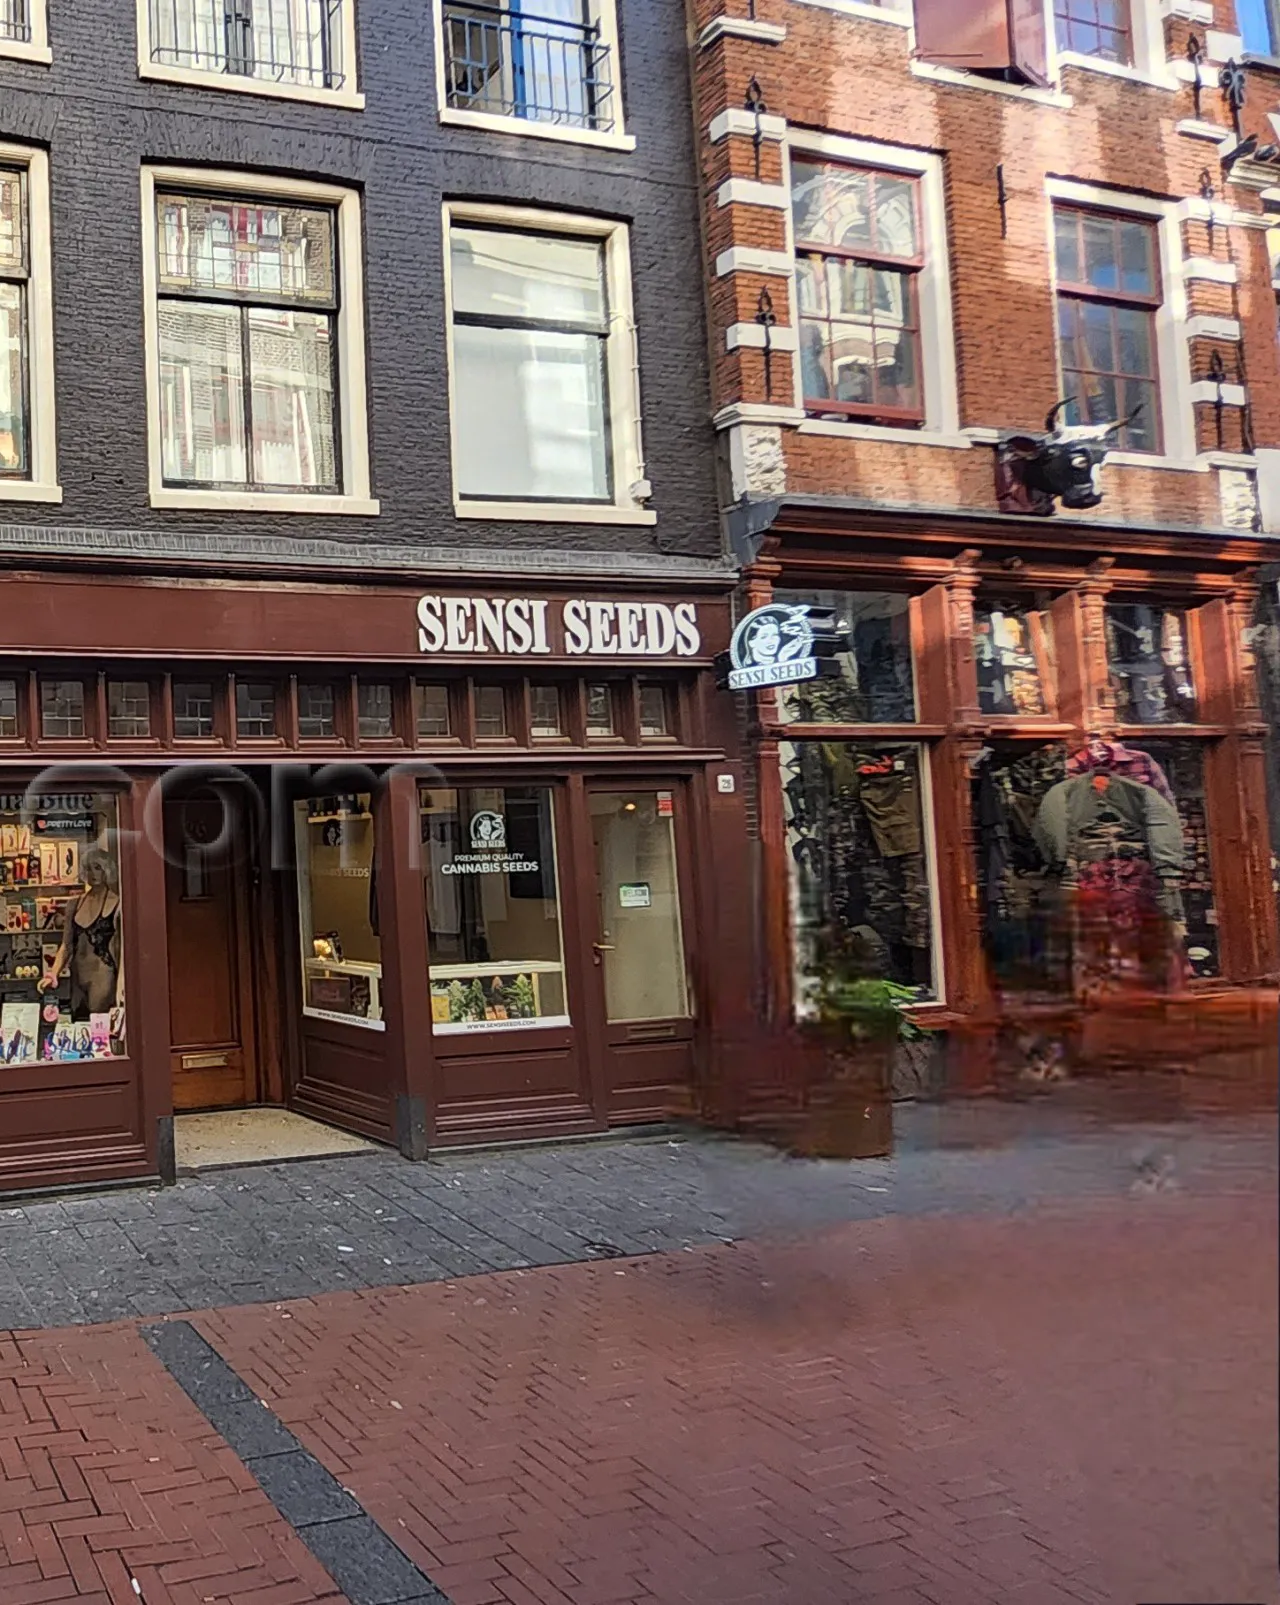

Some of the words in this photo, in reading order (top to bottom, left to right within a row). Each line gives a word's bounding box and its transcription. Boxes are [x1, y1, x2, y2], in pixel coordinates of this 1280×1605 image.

[417, 595, 550, 653] SENSI
[563, 600, 700, 656] SEEDS
[729, 668, 766, 688] SENSI
[770, 661, 812, 681] SEEDS
[454, 854, 491, 863] PREMIUM
[492, 852, 525, 862] QUALITY
[441, 863, 501, 875] CANNABIS
[502, 861, 539, 872] SEEDS
